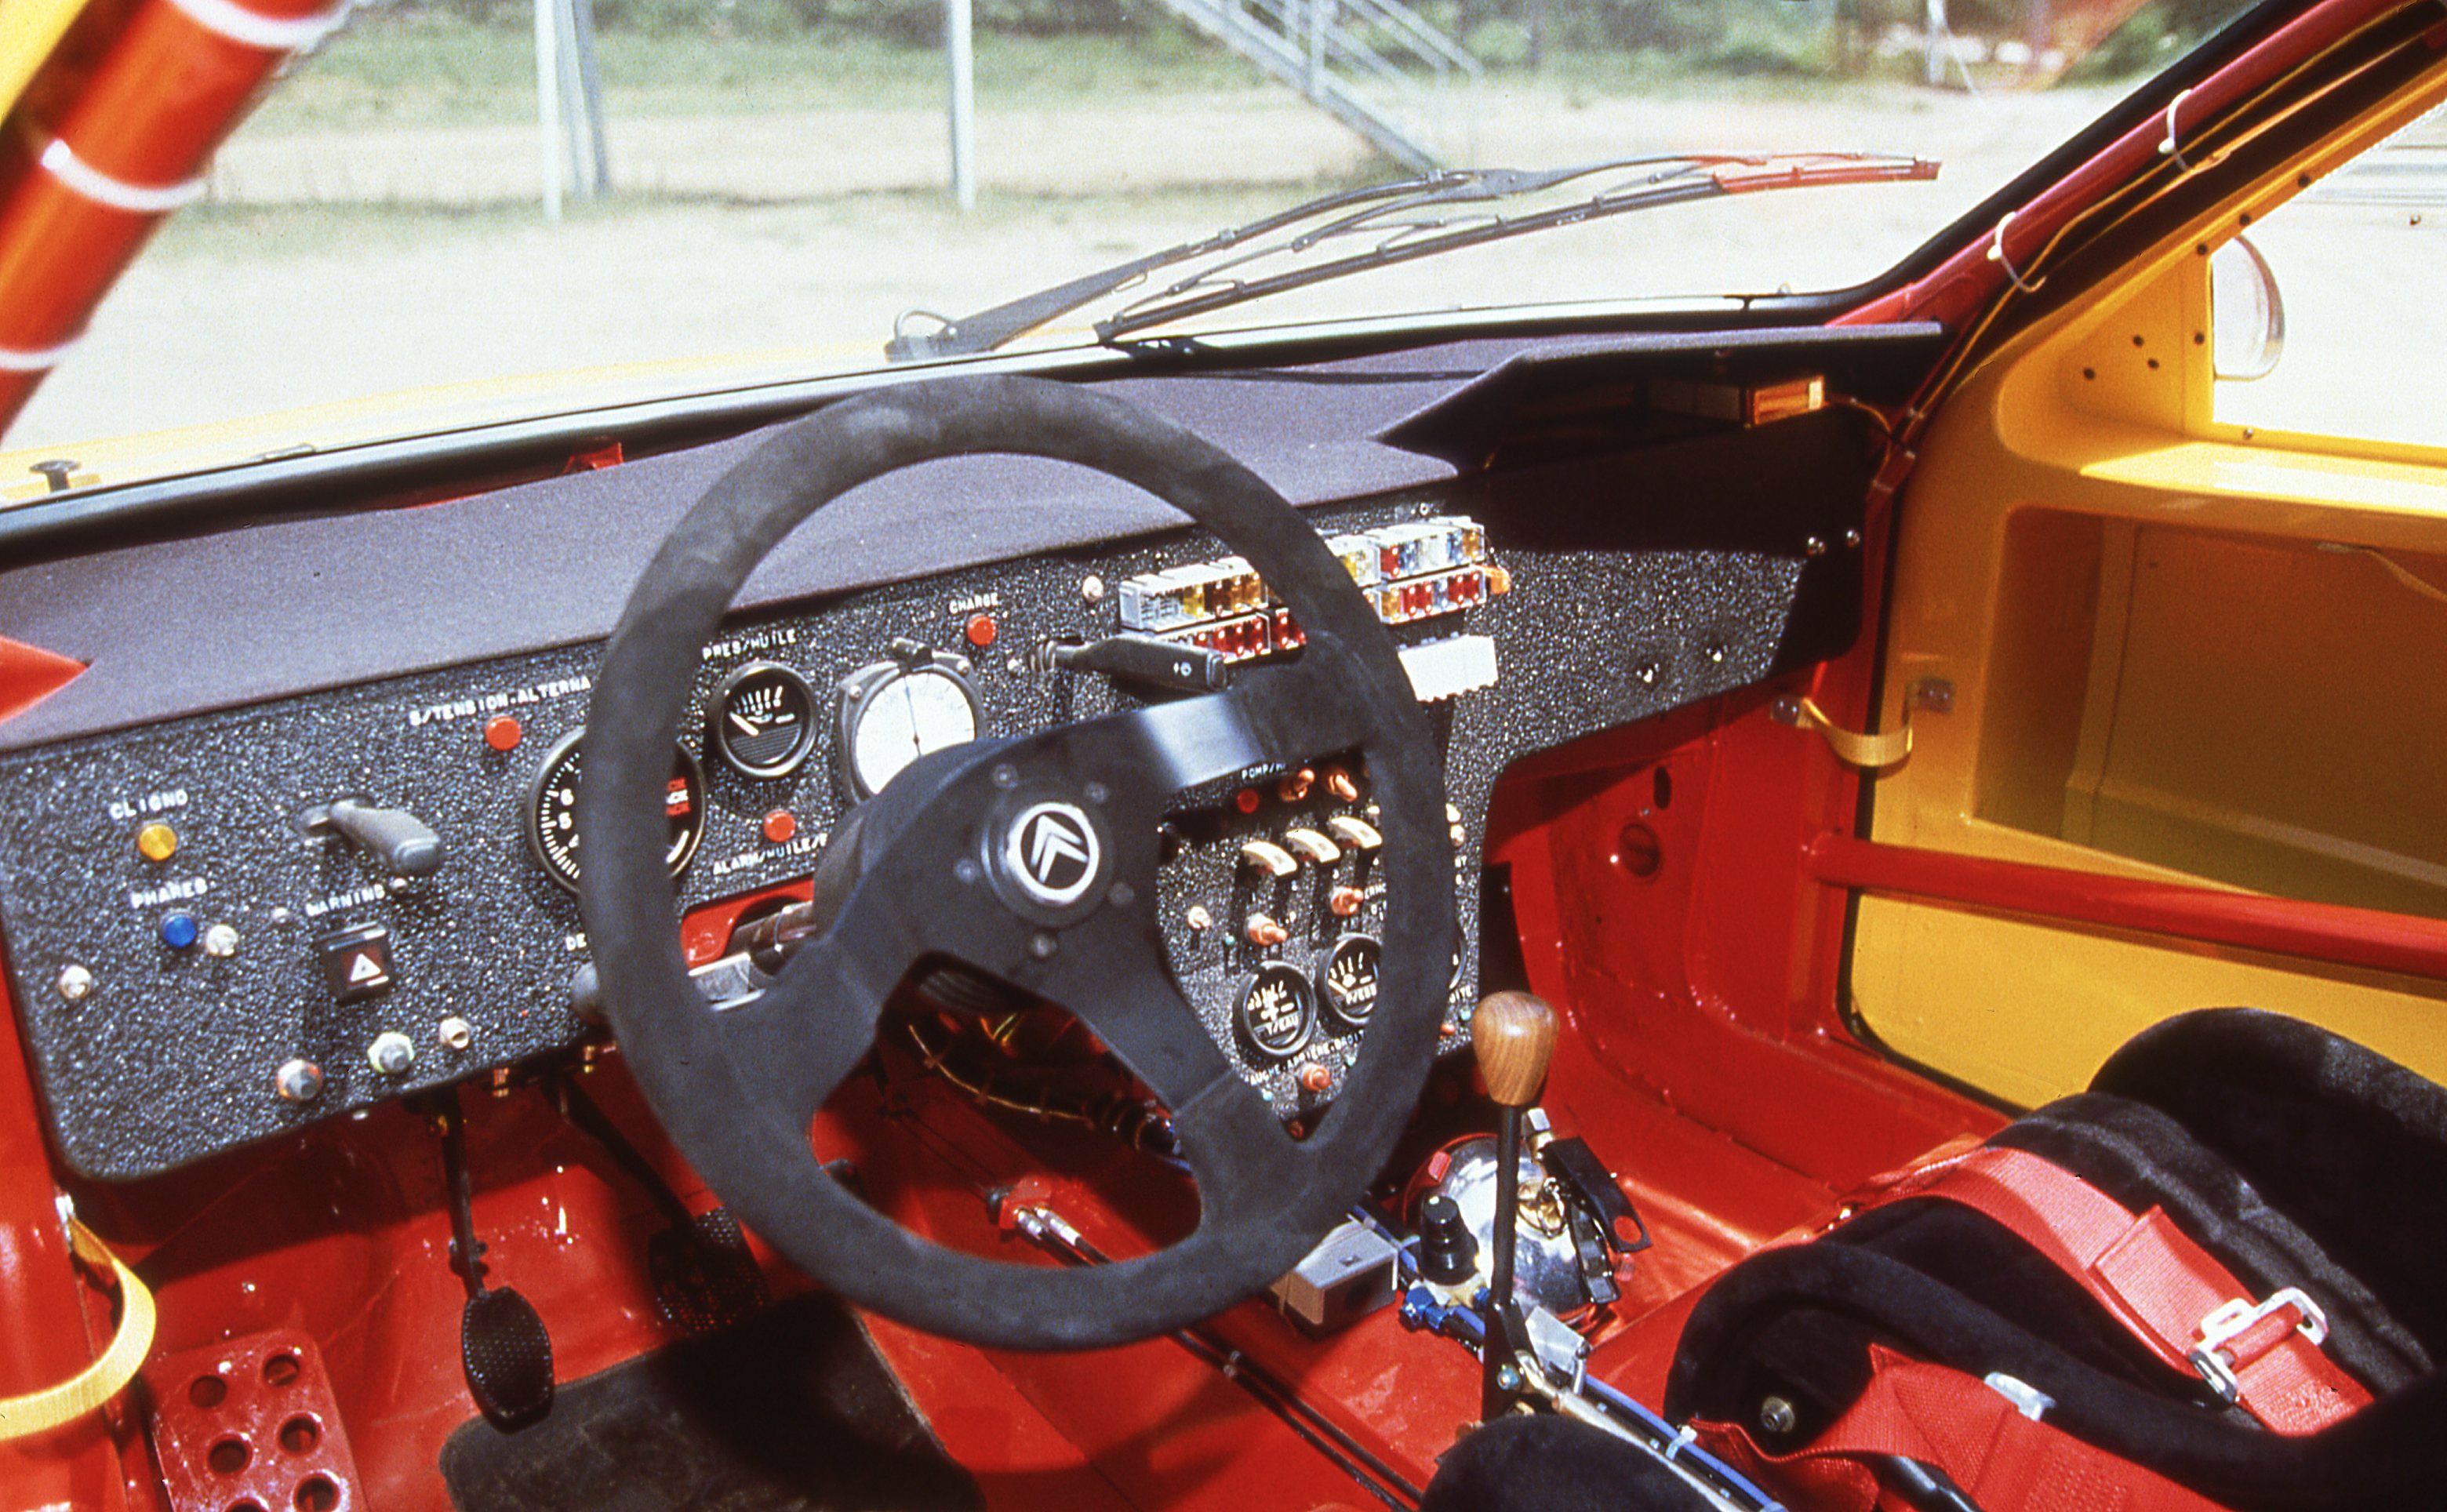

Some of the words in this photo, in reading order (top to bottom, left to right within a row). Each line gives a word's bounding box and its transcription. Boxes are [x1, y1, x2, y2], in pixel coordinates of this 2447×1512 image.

[109, 789, 188, 820] CLIGNO
[560, 788, 574, 805] 6
[558, 812, 572, 830] 5
[131, 877, 208, 908] PHARES
[305, 884, 386, 917] WARNING
